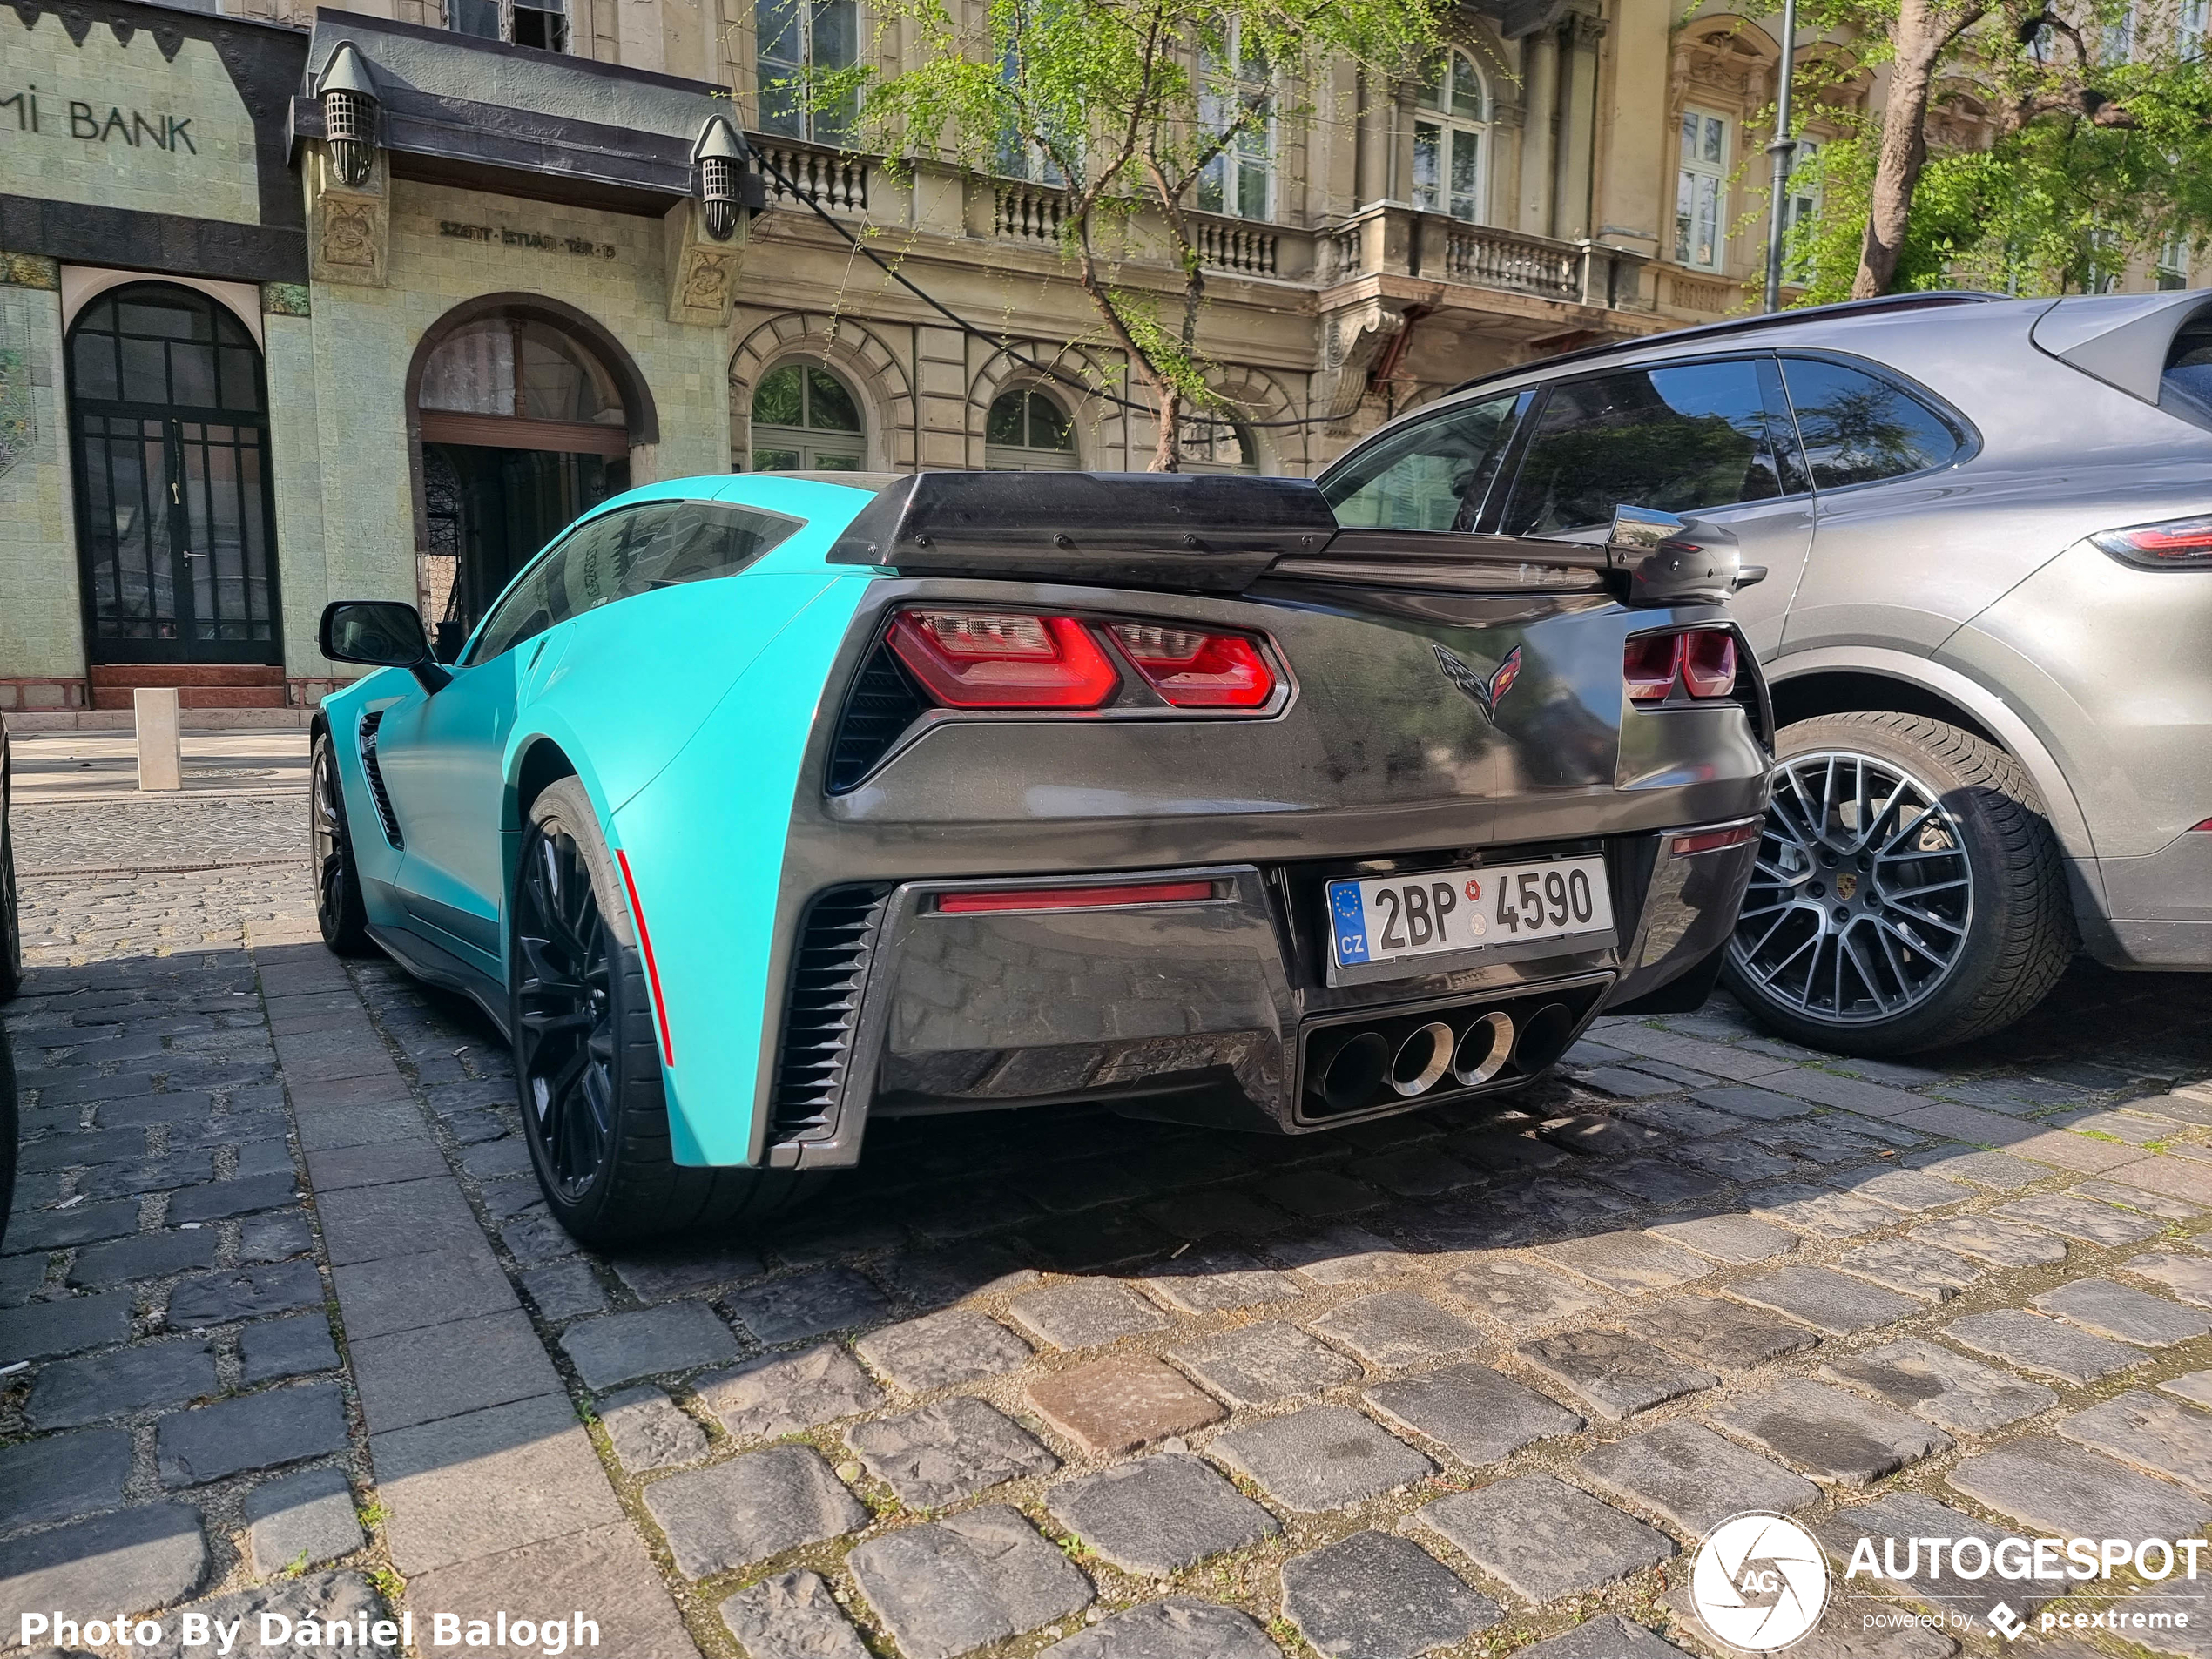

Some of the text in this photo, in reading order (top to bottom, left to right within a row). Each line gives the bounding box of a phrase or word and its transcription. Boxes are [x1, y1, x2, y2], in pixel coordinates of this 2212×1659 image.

[70, 100, 197, 155] BANK
[1375, 868, 1594, 950] 2BP 4590
[1341, 934, 1365, 954] CZ
